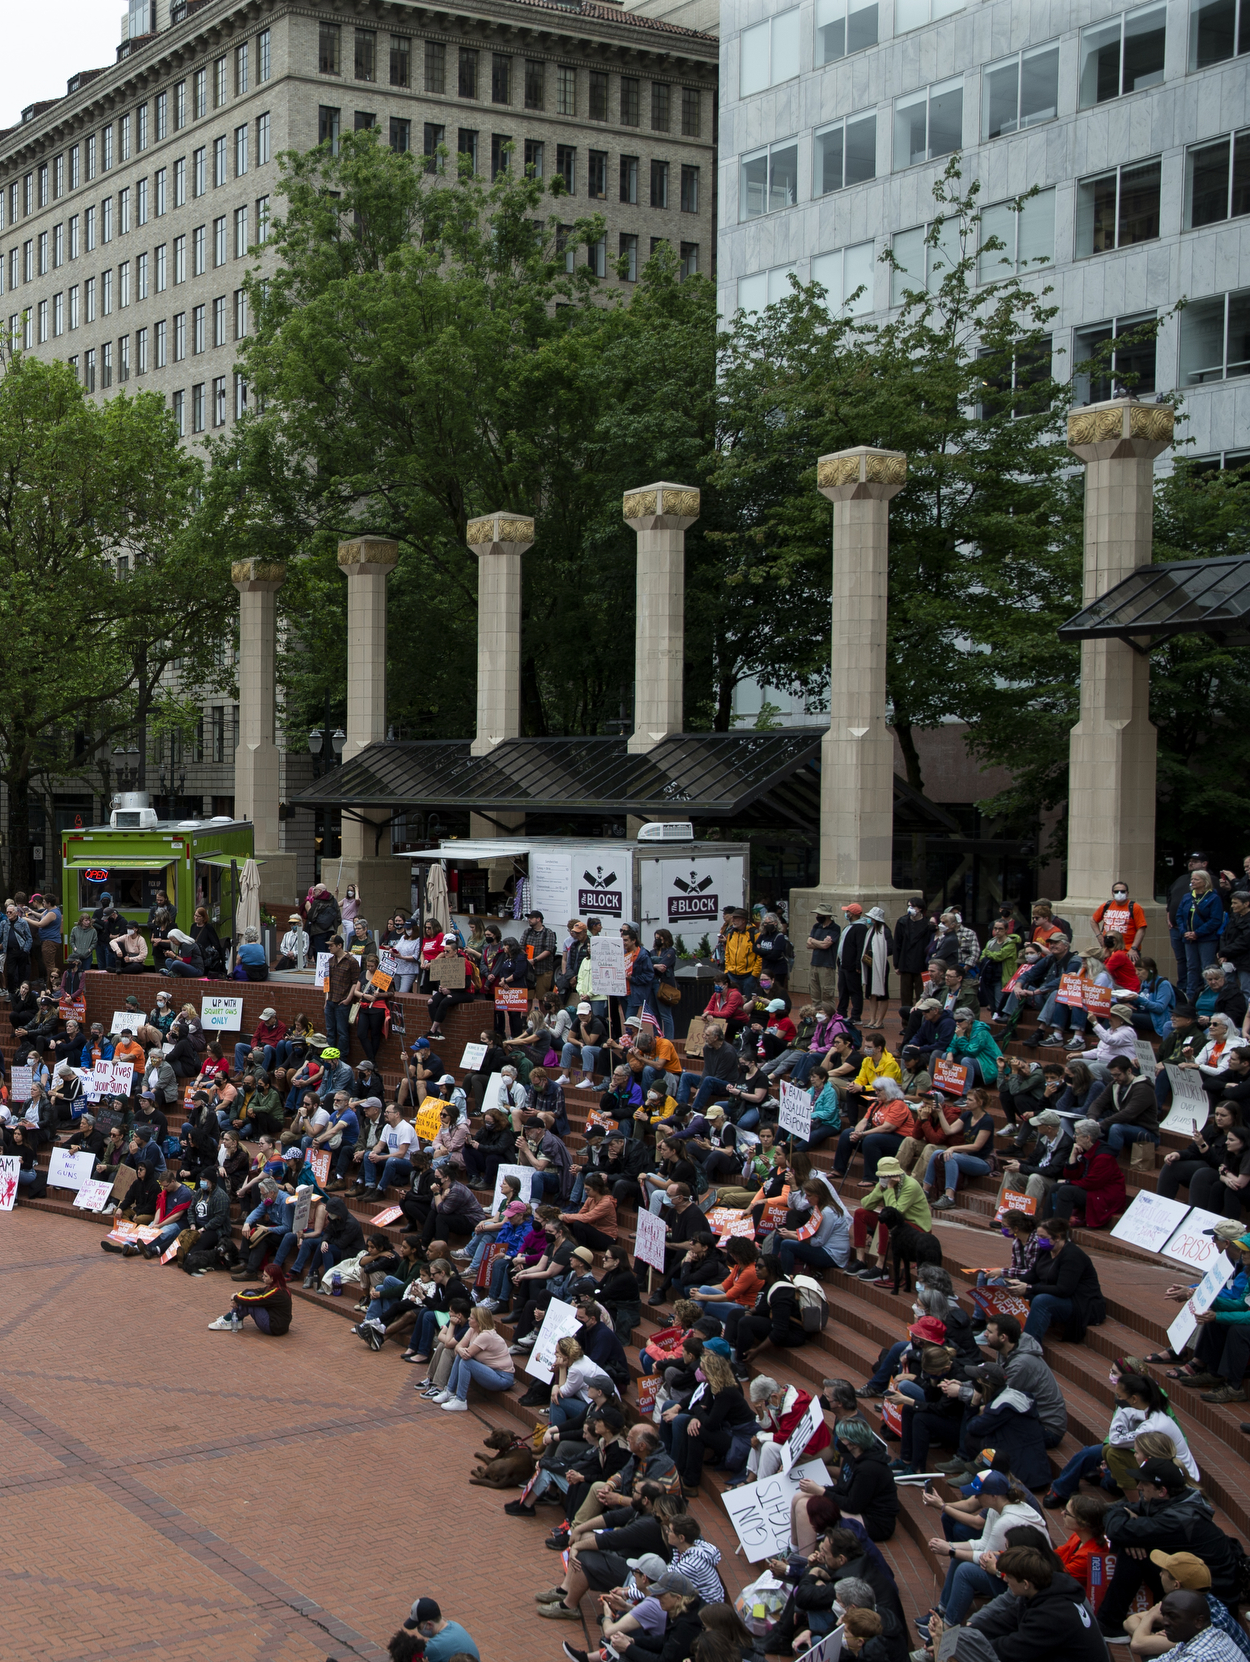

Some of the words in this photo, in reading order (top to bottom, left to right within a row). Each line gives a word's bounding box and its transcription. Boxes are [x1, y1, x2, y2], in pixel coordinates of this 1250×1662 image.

[85, 870, 109, 879] OPEN
[587, 893, 619, 908] BLOCK
[678, 898, 715, 912] BLOCK
[1103, 909, 1131, 920] ENOUGH
[212, 999, 221, 1007] UP
[224, 999, 237, 1007] WITH
[211, 1017, 228, 1025] ONLY
[112, 1063, 131, 1079] lives
[949, 1070, 958, 1078] End
[1169, 1066, 1195, 1084] VALUE
[933, 1073, 944, 1081] Gun
[944, 1076, 965, 1086] Violence
[788, 1085, 802, 1101] BAN
[1170, 1080, 1207, 1103] CHILDREN
[782, 1097, 811, 1119] ASSAULT
[1180, 1102, 1195, 1112] over
[780, 1110, 810, 1135] WEAPONS
[1166, 1115, 1191, 1126] guns
[57, 1170, 78, 1180] GUNS
[320, 1154, 329, 1183] Educators
[95, 1188, 107, 1196] FUN
[1005, 1192, 1031, 1205] Educators
[86, 1200, 101, 1209] GUNS
[1009, 1200, 1015, 1208] to
[1015, 1201, 1026, 1210] End
[710, 1208, 744, 1216] Educators
[116, 1220, 134, 1229] Educators
[727, 1217, 753, 1229] Educators
[759, 1220, 773, 1228] Gun
[1171, 1234, 1215, 1262] CRISIS
[976, 1286, 992, 1301] Gun
[995, 1290, 1004, 1300] to
[1003, 1297, 1021, 1316] End
[640, 1397, 653, 1406] Gun
[755, 1480, 791, 1552] RIGHTS
[732, 1505, 768, 1546] GUN
[1092, 1556, 1101, 1571] nea
